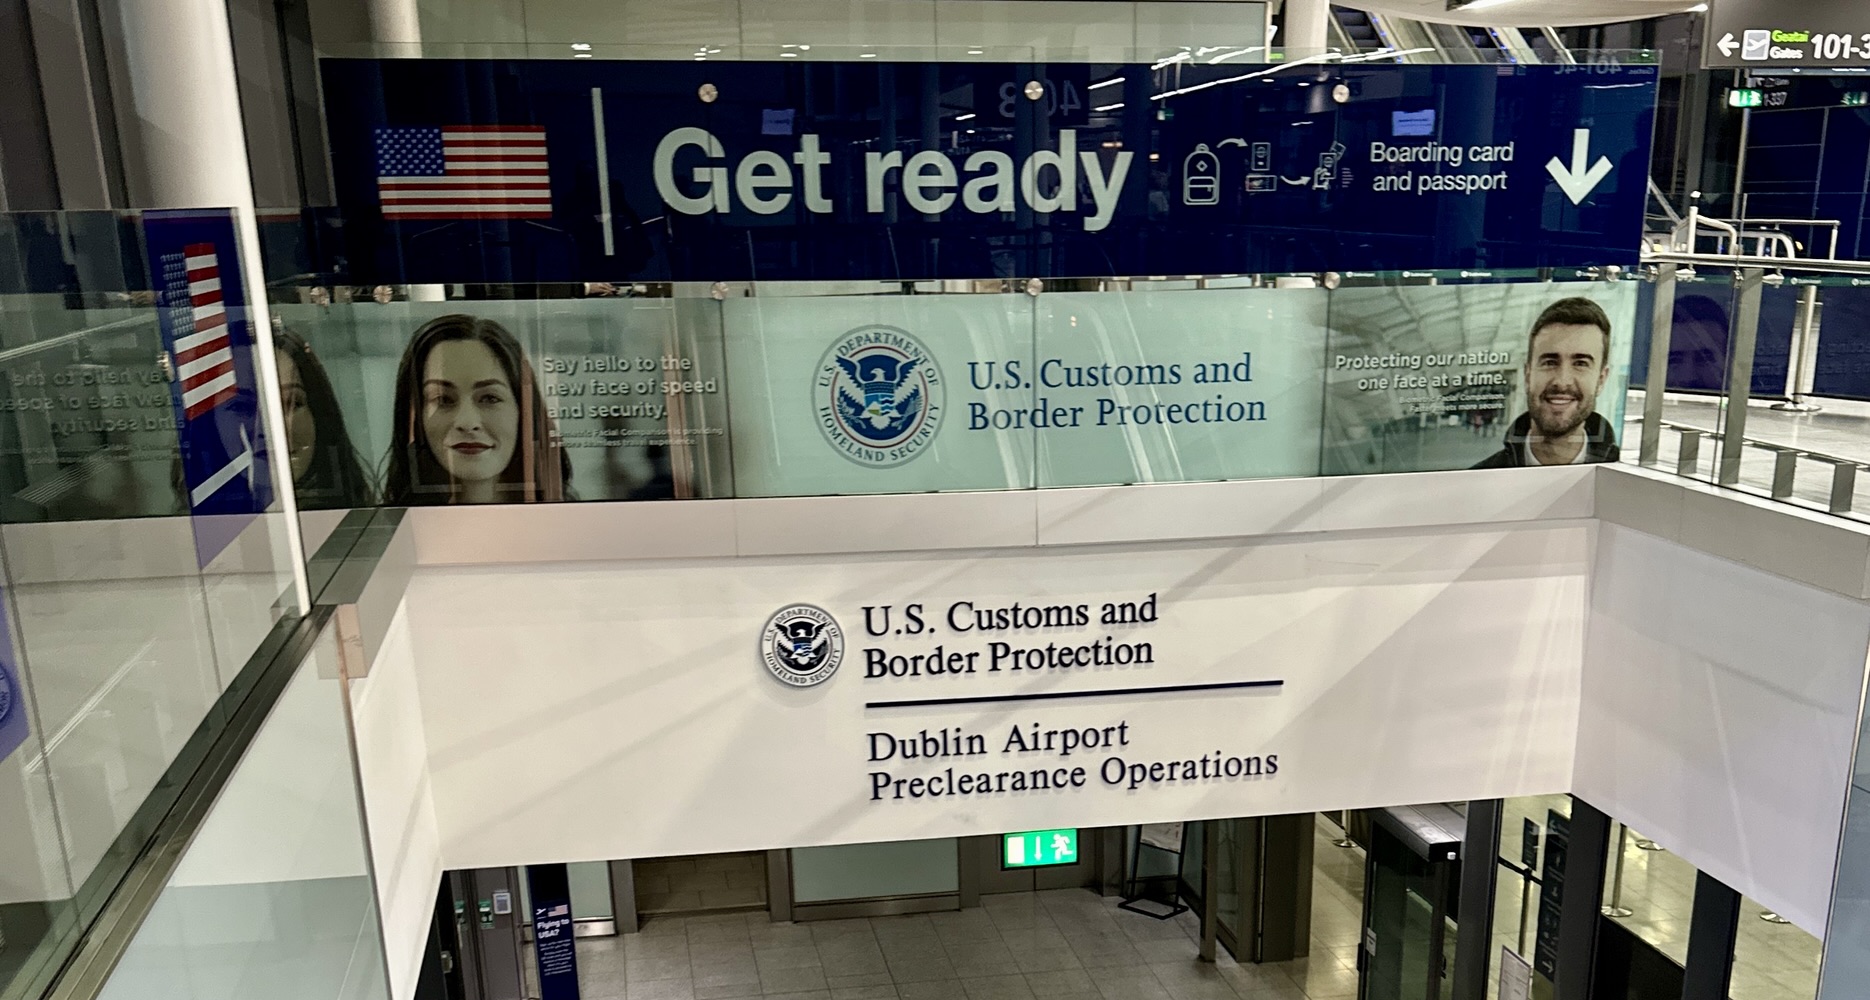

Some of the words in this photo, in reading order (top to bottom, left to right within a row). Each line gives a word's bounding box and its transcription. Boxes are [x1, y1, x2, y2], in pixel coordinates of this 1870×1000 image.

[1770, 46, 1803, 59] Gates
[1370, 142, 1463, 167] Boarding
[1468, 141, 1515, 162] card
[652, 127, 832, 215] Get
[865, 129, 1134, 232] ready
[1373, 170, 1412, 191] and
[1417, 171, 1508, 195] passport
[544, 357, 578, 375] Say
[583, 355, 630, 373] hello
[636, 356, 656, 372] to
[661, 355, 692, 372] the
[837, 332, 930, 366] DEPARTMENT
[925, 367, 940, 387] OF
[968, 361, 1031, 390] U.S.
[1040, 359, 1182, 388] Customs
[1193, 352, 1253, 384] and
[1335, 353, 1421, 370] Protecting
[1426, 353, 1453, 367] our
[1458, 350, 1509, 365] nation
[546, 383, 585, 396] new
[590, 379, 630, 395] face
[635, 378, 656, 395] of
[661, 377, 717, 397] speed
[1358, 377, 1389, 391] one
[1393, 374, 1427, 389] face
[1432, 375, 1448, 388] at
[1453, 376, 1462, 387] a
[1466, 372, 1507, 386] time.
[548, 402, 584, 419] and
[589, 401, 668, 420] security.
[968, 398, 1084, 430] Border
[1096, 395, 1267, 426] Protection
[820, 406, 885, 462] HOMELAND
[890, 403, 940, 461] SECURITY
[775, 608, 832, 627] DEPARTMENT
[862, 603, 935, 636] U.S.
[947, 601, 1090, 632] Customs
[1100, 592, 1159, 625] and
[765, 652, 808, 684] HOMELAND
[809, 649, 840, 682] SECURITY
[863, 646, 980, 678] Border
[988, 636, 1155, 672] Protection
[867, 727, 988, 762] Dublin
[1002, 720, 1130, 756] Airport
[868, 765, 1087, 801] Preclearance
[1100, 750, 1279, 789] Operations
[537, 920, 560, 930] Flying
[538, 928, 560, 939] USA?
